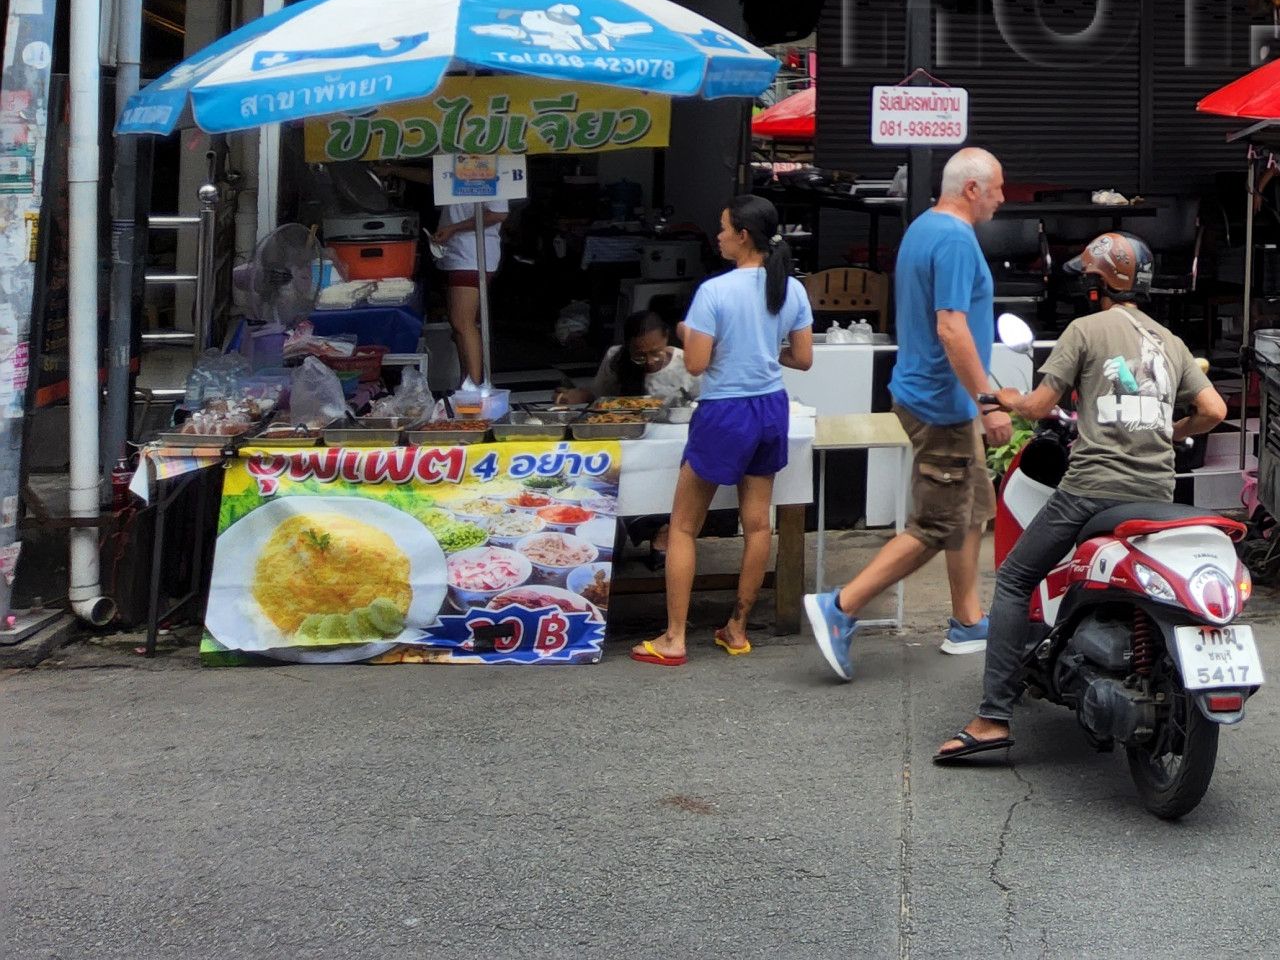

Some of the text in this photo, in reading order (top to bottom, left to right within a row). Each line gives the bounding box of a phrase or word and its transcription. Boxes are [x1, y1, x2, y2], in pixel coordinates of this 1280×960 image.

[240, 73, 393, 118] สาขาพัทยา
[880, 90, 961, 113] รับสมัครพนักงาน
[325, 92, 651, 161] ข้าวไข่เจียว
[880, 120, 961, 137] 081-9362953
[473, 451, 499, 482] 4
[509, 442, 612, 478] อย่าง
[1197, 665, 1250, 685] 5417
